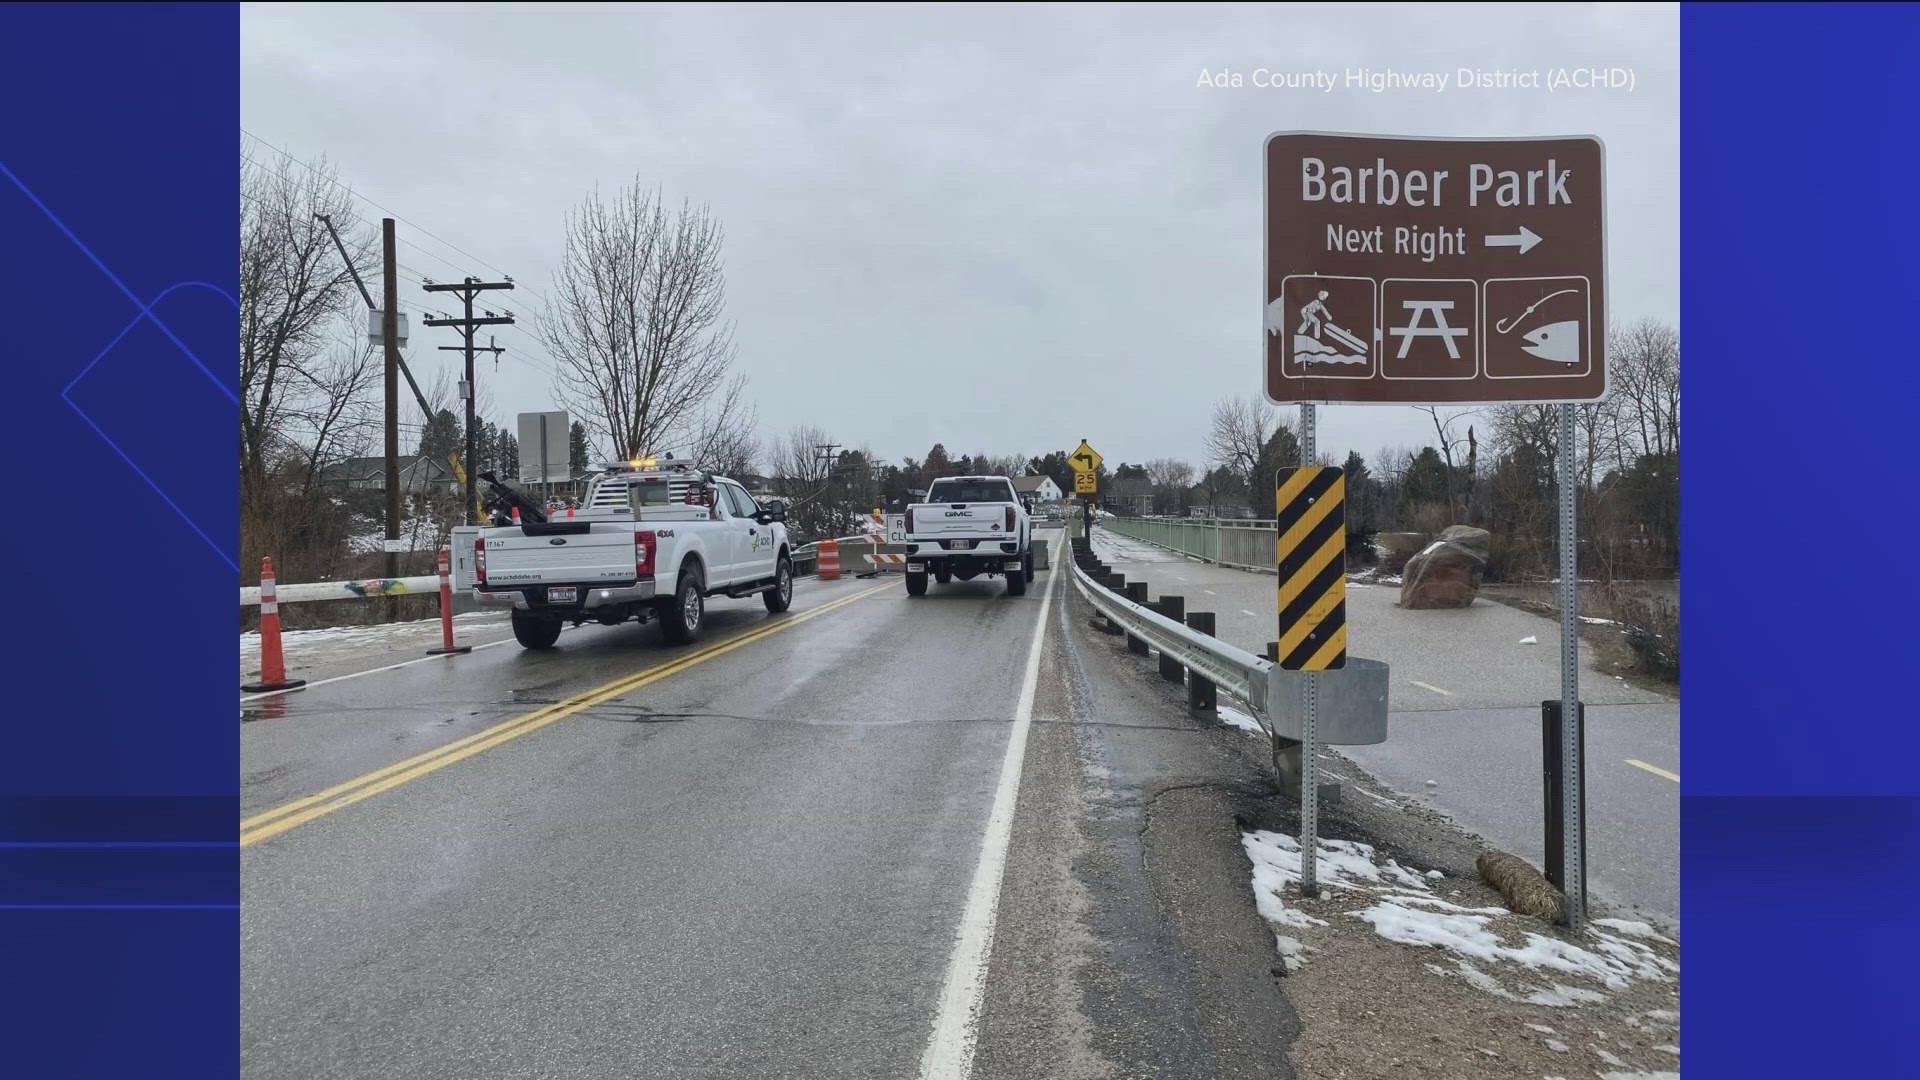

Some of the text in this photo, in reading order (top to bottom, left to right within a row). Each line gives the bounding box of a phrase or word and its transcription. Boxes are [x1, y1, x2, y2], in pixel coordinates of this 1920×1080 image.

[1302, 157, 1573, 207] Barber Park
[1326, 224, 1466, 263] Next Right
[1077, 474, 1094, 484] 25
